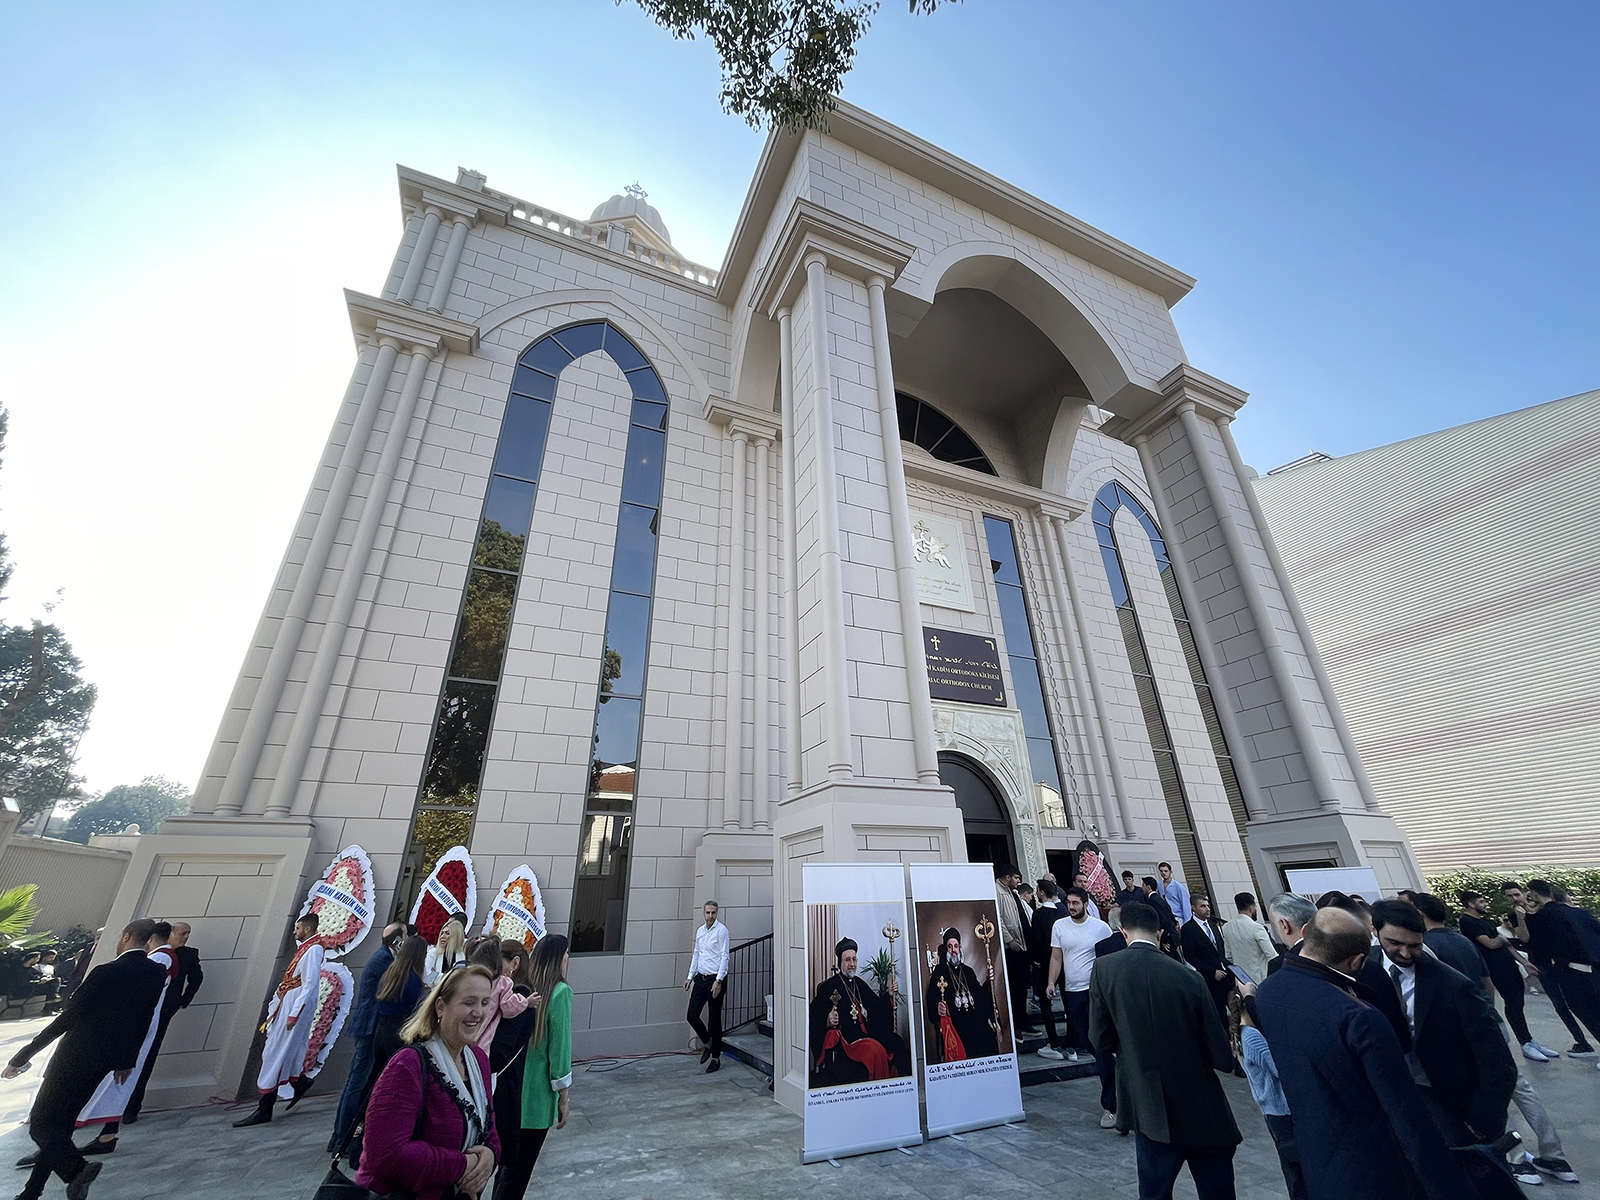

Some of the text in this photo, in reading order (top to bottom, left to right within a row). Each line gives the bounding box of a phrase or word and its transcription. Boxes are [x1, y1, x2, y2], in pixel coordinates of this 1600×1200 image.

[932, 665, 951, 673] KADİM
[951, 668, 979, 677] ORTODOKS
[941, 678, 971, 688] ORTHODOX
[971, 683, 992, 691] CHURCH
[333, 890, 356, 907] KATOLİK
[438, 890, 456, 909] KATOLİK
[505, 903, 529, 921] ORTODOKS
